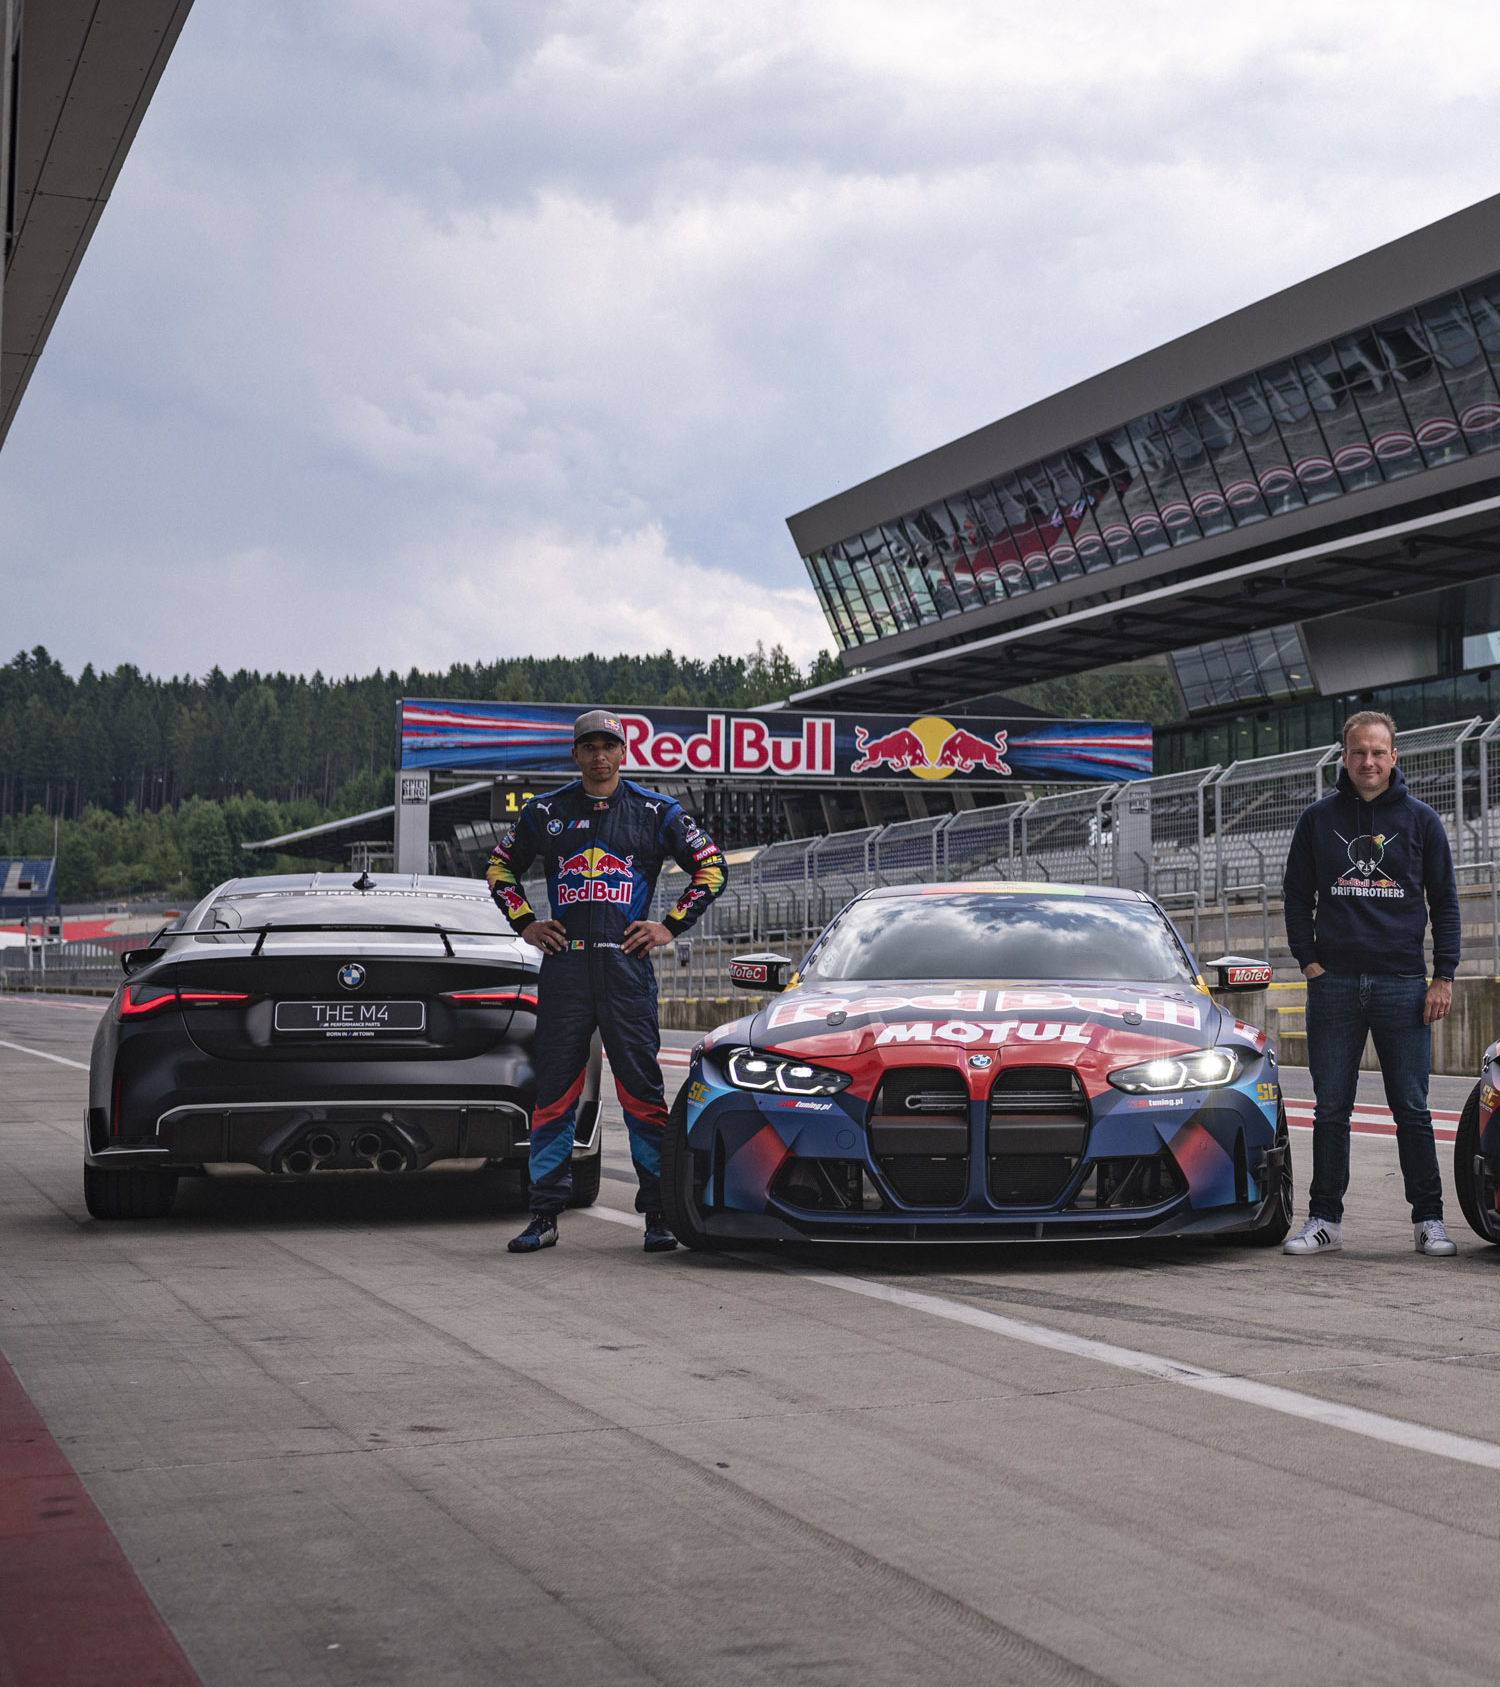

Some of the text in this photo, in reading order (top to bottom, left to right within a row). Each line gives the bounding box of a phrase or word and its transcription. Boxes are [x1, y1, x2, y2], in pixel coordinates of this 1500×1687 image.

[618, 713, 836, 775] Red Bull
[1338, 877, 1370, 887] Red Bull
[304, 890, 439, 899] PERFORMANCE
[558, 880, 633, 905] Red Bull
[1331, 886, 1405, 898] DRIFTBROTHERS
[1234, 969, 1270, 981] MoTeC
[312, 1005, 389, 1021] THE M4
[769, 991, 1201, 1030] Red Bull
[874, 1023, 1093, 1046] MOTUL
